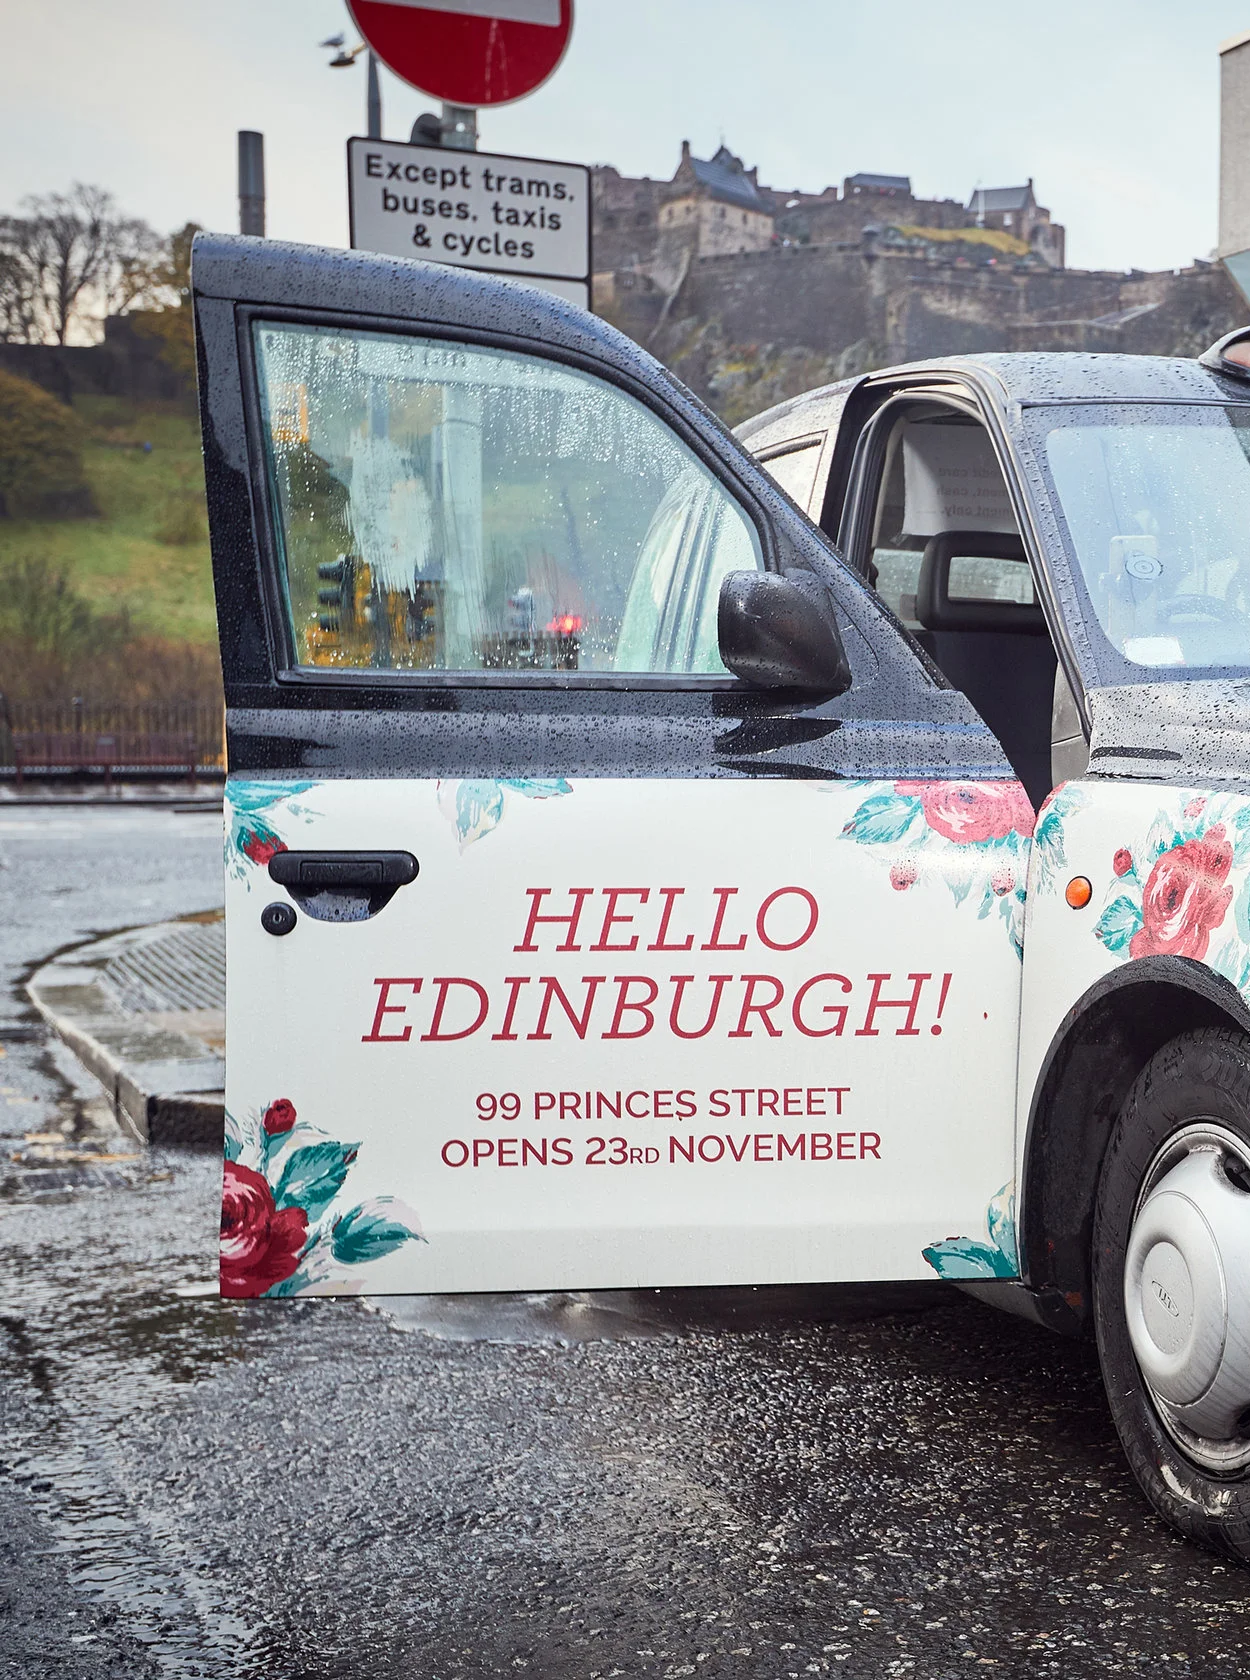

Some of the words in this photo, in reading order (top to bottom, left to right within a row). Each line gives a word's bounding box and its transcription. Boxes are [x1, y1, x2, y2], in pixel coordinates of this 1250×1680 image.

[365, 153, 471, 190] Except
[492, 202, 562, 231] taxis
[412, 224, 431, 248] &
[443, 232, 535, 259] cycles
[513, 886, 819, 952] HELLO
[361, 972, 953, 1043] EDINBURGH!
[475, 1092, 521, 1121] 99
[534, 1089, 698, 1120] PRINCES
[708, 1087, 851, 1118] STREET
[441, 1138, 574, 1168] OPENS
[585, 1136, 660, 1166] 23RD
[668, 1131, 883, 1165] NOVEMBER
